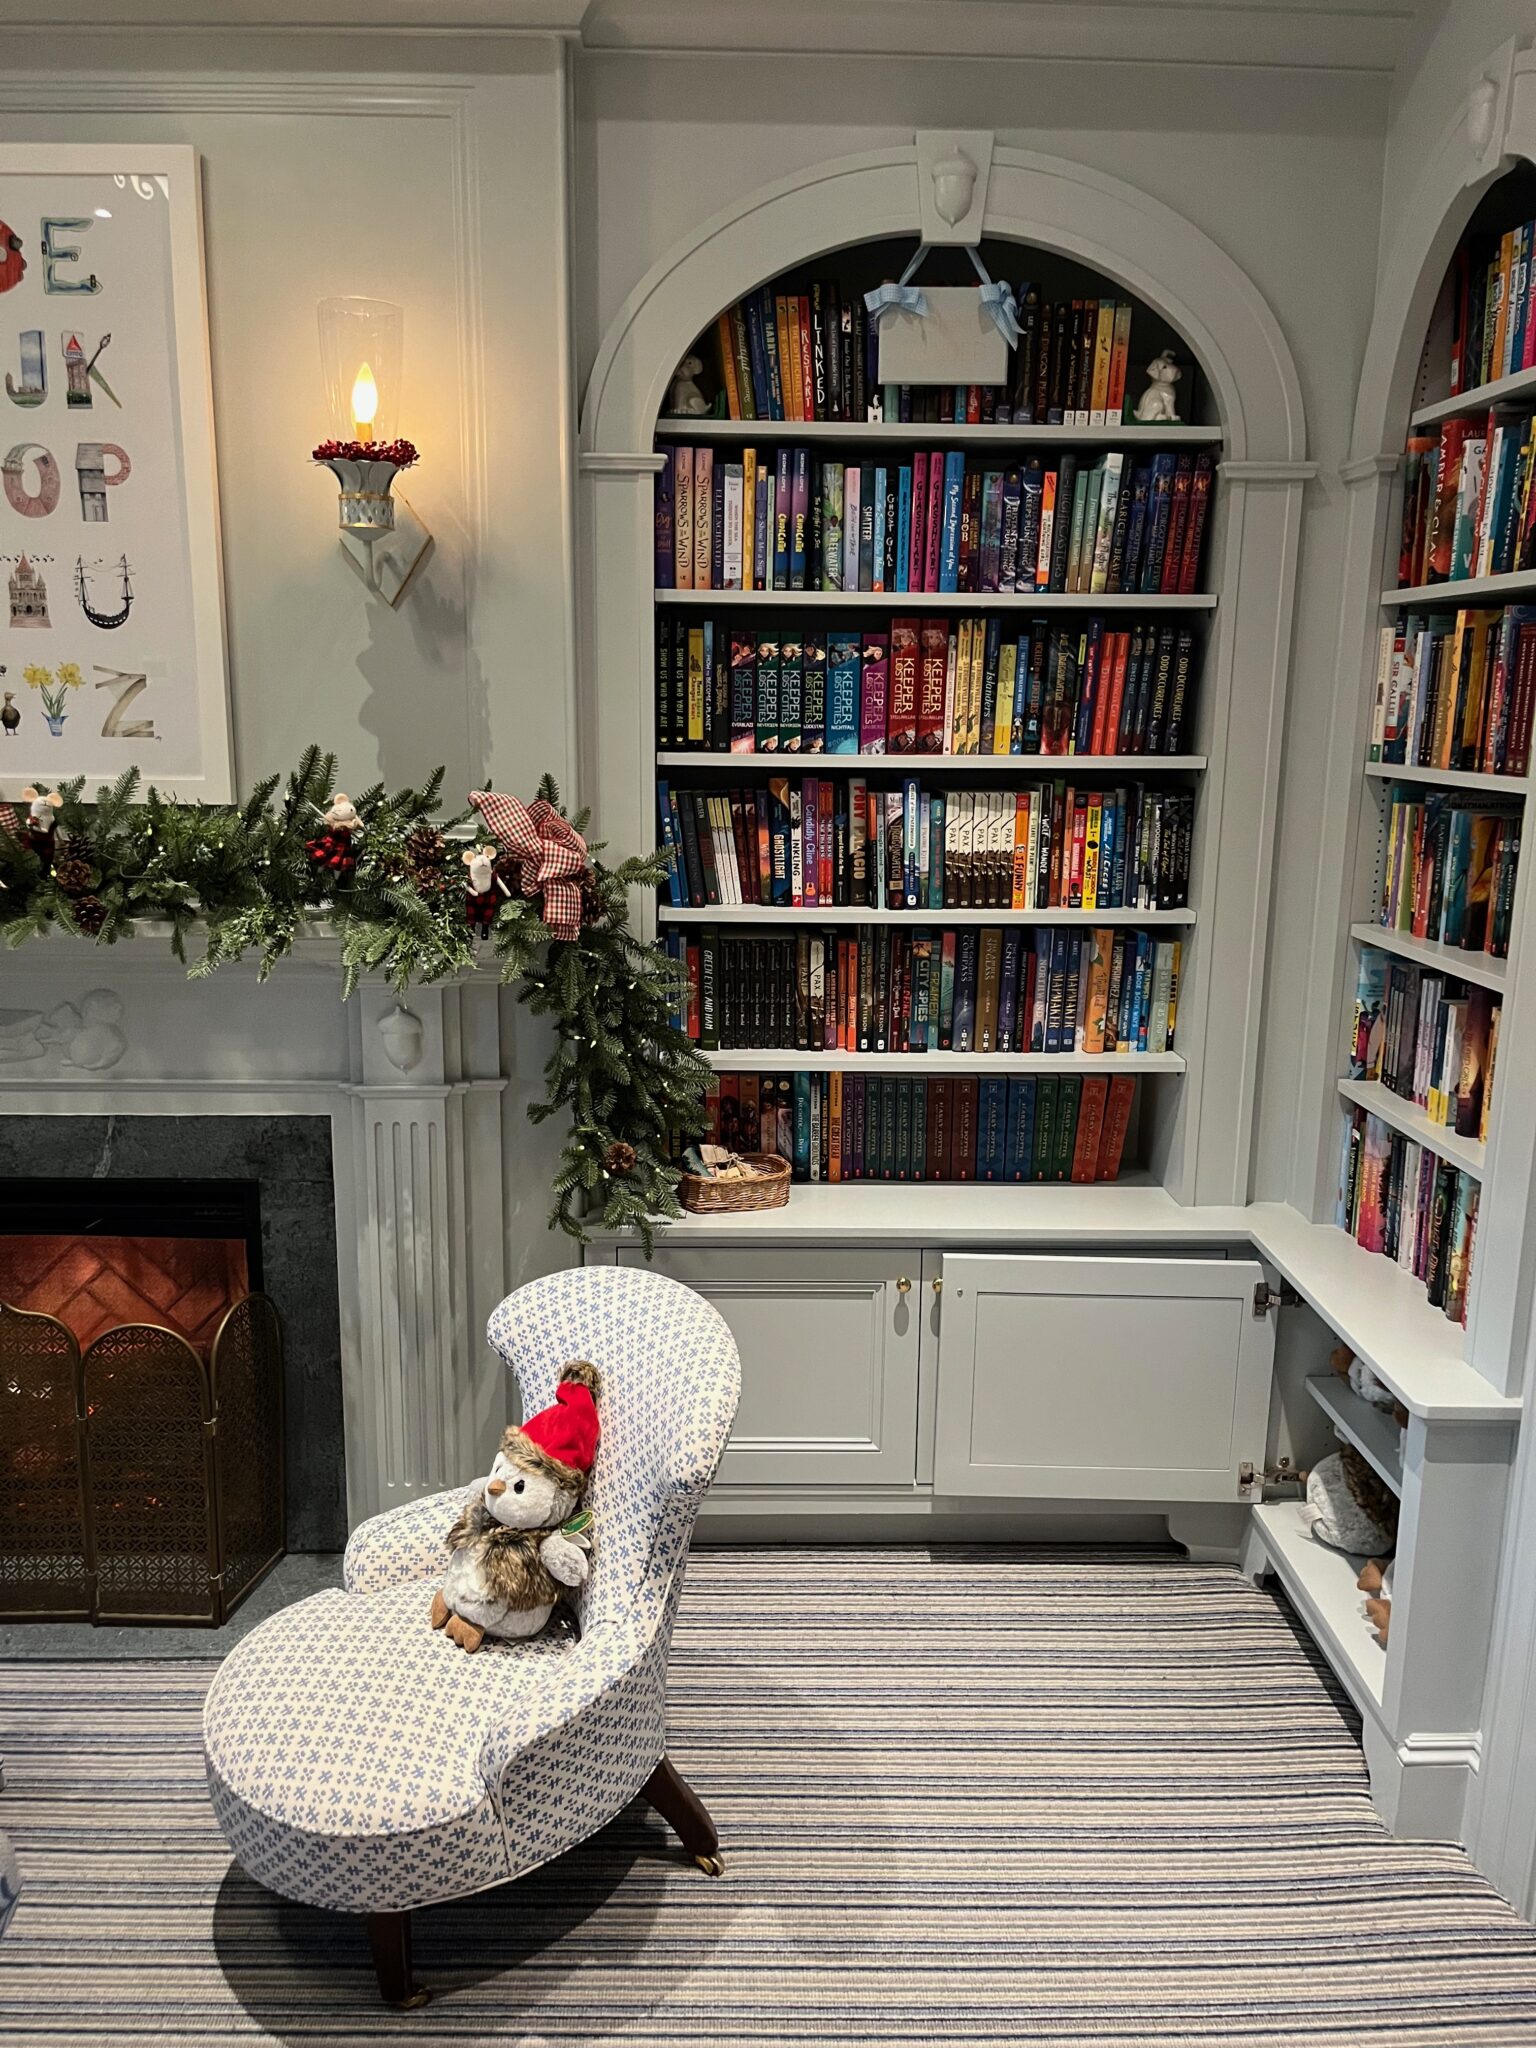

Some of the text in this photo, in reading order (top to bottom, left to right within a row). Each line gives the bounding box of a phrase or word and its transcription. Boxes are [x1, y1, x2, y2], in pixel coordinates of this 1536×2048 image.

[735, 320, 750, 372] Beautiful
[801, 329, 812, 408] RESTART
[814, 314, 825, 404] LINKED
[1038, 337, 1048, 409] DRAGON PEARL
[1435, 434, 1448, 493] AMBER
[677, 473, 690, 568] SPARROWS WIND
[697, 475, 710, 569] SPARROWS WIND
[714, 514, 723, 568] ENCHANTED
[862, 506, 872, 541] SHATTER
[886, 494, 895, 567] GHOST GIRL
[946, 484, 959, 570] My Second Impression You
[961, 513, 969, 542] BOB
[1022, 493, 1033, 566] KEEPS PUNCHING
[1111, 489, 1131, 579] CLARICE BRAVE
[1429, 516, 1439, 563] CLAY
[757, 559, 765, 576] Sign
[828, 532, 838, 578] FREEWATER
[660, 648, 668, 728] SHOW US WHO YOU ARE
[676, 648, 684, 728] SHOW US WHO YOU ARE
[733, 669, 742, 722] LOST CITIES
[742, 669, 753, 720] KEEPER
[758, 669, 766, 723] LOST CITIES
[766, 669, 777, 721] KEEPER
[781, 670, 790, 723] LOST CITIES
[789, 670, 800, 721] KEEPER
[805, 671, 813, 723] LOST CITIES
[812, 671, 824, 722] KEEPER
[833, 671, 842, 724] LOST CITIES
[842, 671, 853, 723] KEEPER
[865, 672, 873, 725] LOST CITIES
[873, 672, 885, 725] KEEPER
[893, 658, 903, 714] LOST CITIES
[903, 658, 914, 712] KEEPER
[921, 659, 931, 715] LOST CITIES
[930, 659, 943, 713] KEEPER
[984, 671, 995, 718] Islanders
[1153, 655, 1170, 720] ODD OCCURRENCES
[1172, 657, 1189, 721] ODD OCCURRENCES
[1492, 670, 1502, 708] TOWN
[853, 786, 865, 819] PONY
[773, 834, 785, 880] GHOSTLIGHT
[792, 839, 801, 877] INKLING
[804, 804, 815, 865] Candidly Cline
[853, 825, 865, 879] PALACIO
[949, 827, 957, 844] PAX
[962, 830, 970, 847] PAX
[977, 829, 985, 845] PAX
[1040, 818, 1050, 874] WOLF WANDER
[1015, 863, 1024, 891] FUNNY
[961, 934, 969, 982] COMPASS
[984, 937, 992, 981] SPYGLASS
[1004, 943, 1012, 978] KNIFE
[1110, 965, 1122, 998] RAMIREZ
[1135, 972, 1143, 989] LOOK
[704, 950, 713, 1030] GREEN EYES AND HAM
[918, 960, 929, 1022] CITY SPIES
[1035, 959, 1047, 1018] NORTHWIND
[1048, 973, 1064, 1029] MAPMAKER
[1064, 973, 1079, 1029] MAPMAKER
[1169, 974, 1178, 1004] GHOST
[1132, 1011, 1140, 1028] WAYS
[831, 1127, 841, 1144] GREAT
[1018, 1131, 1026, 1158] POTTER
[1084, 1104, 1096, 1160] HARRY POTTER
[1108, 1101, 1123, 1157] HARRY POTTER
